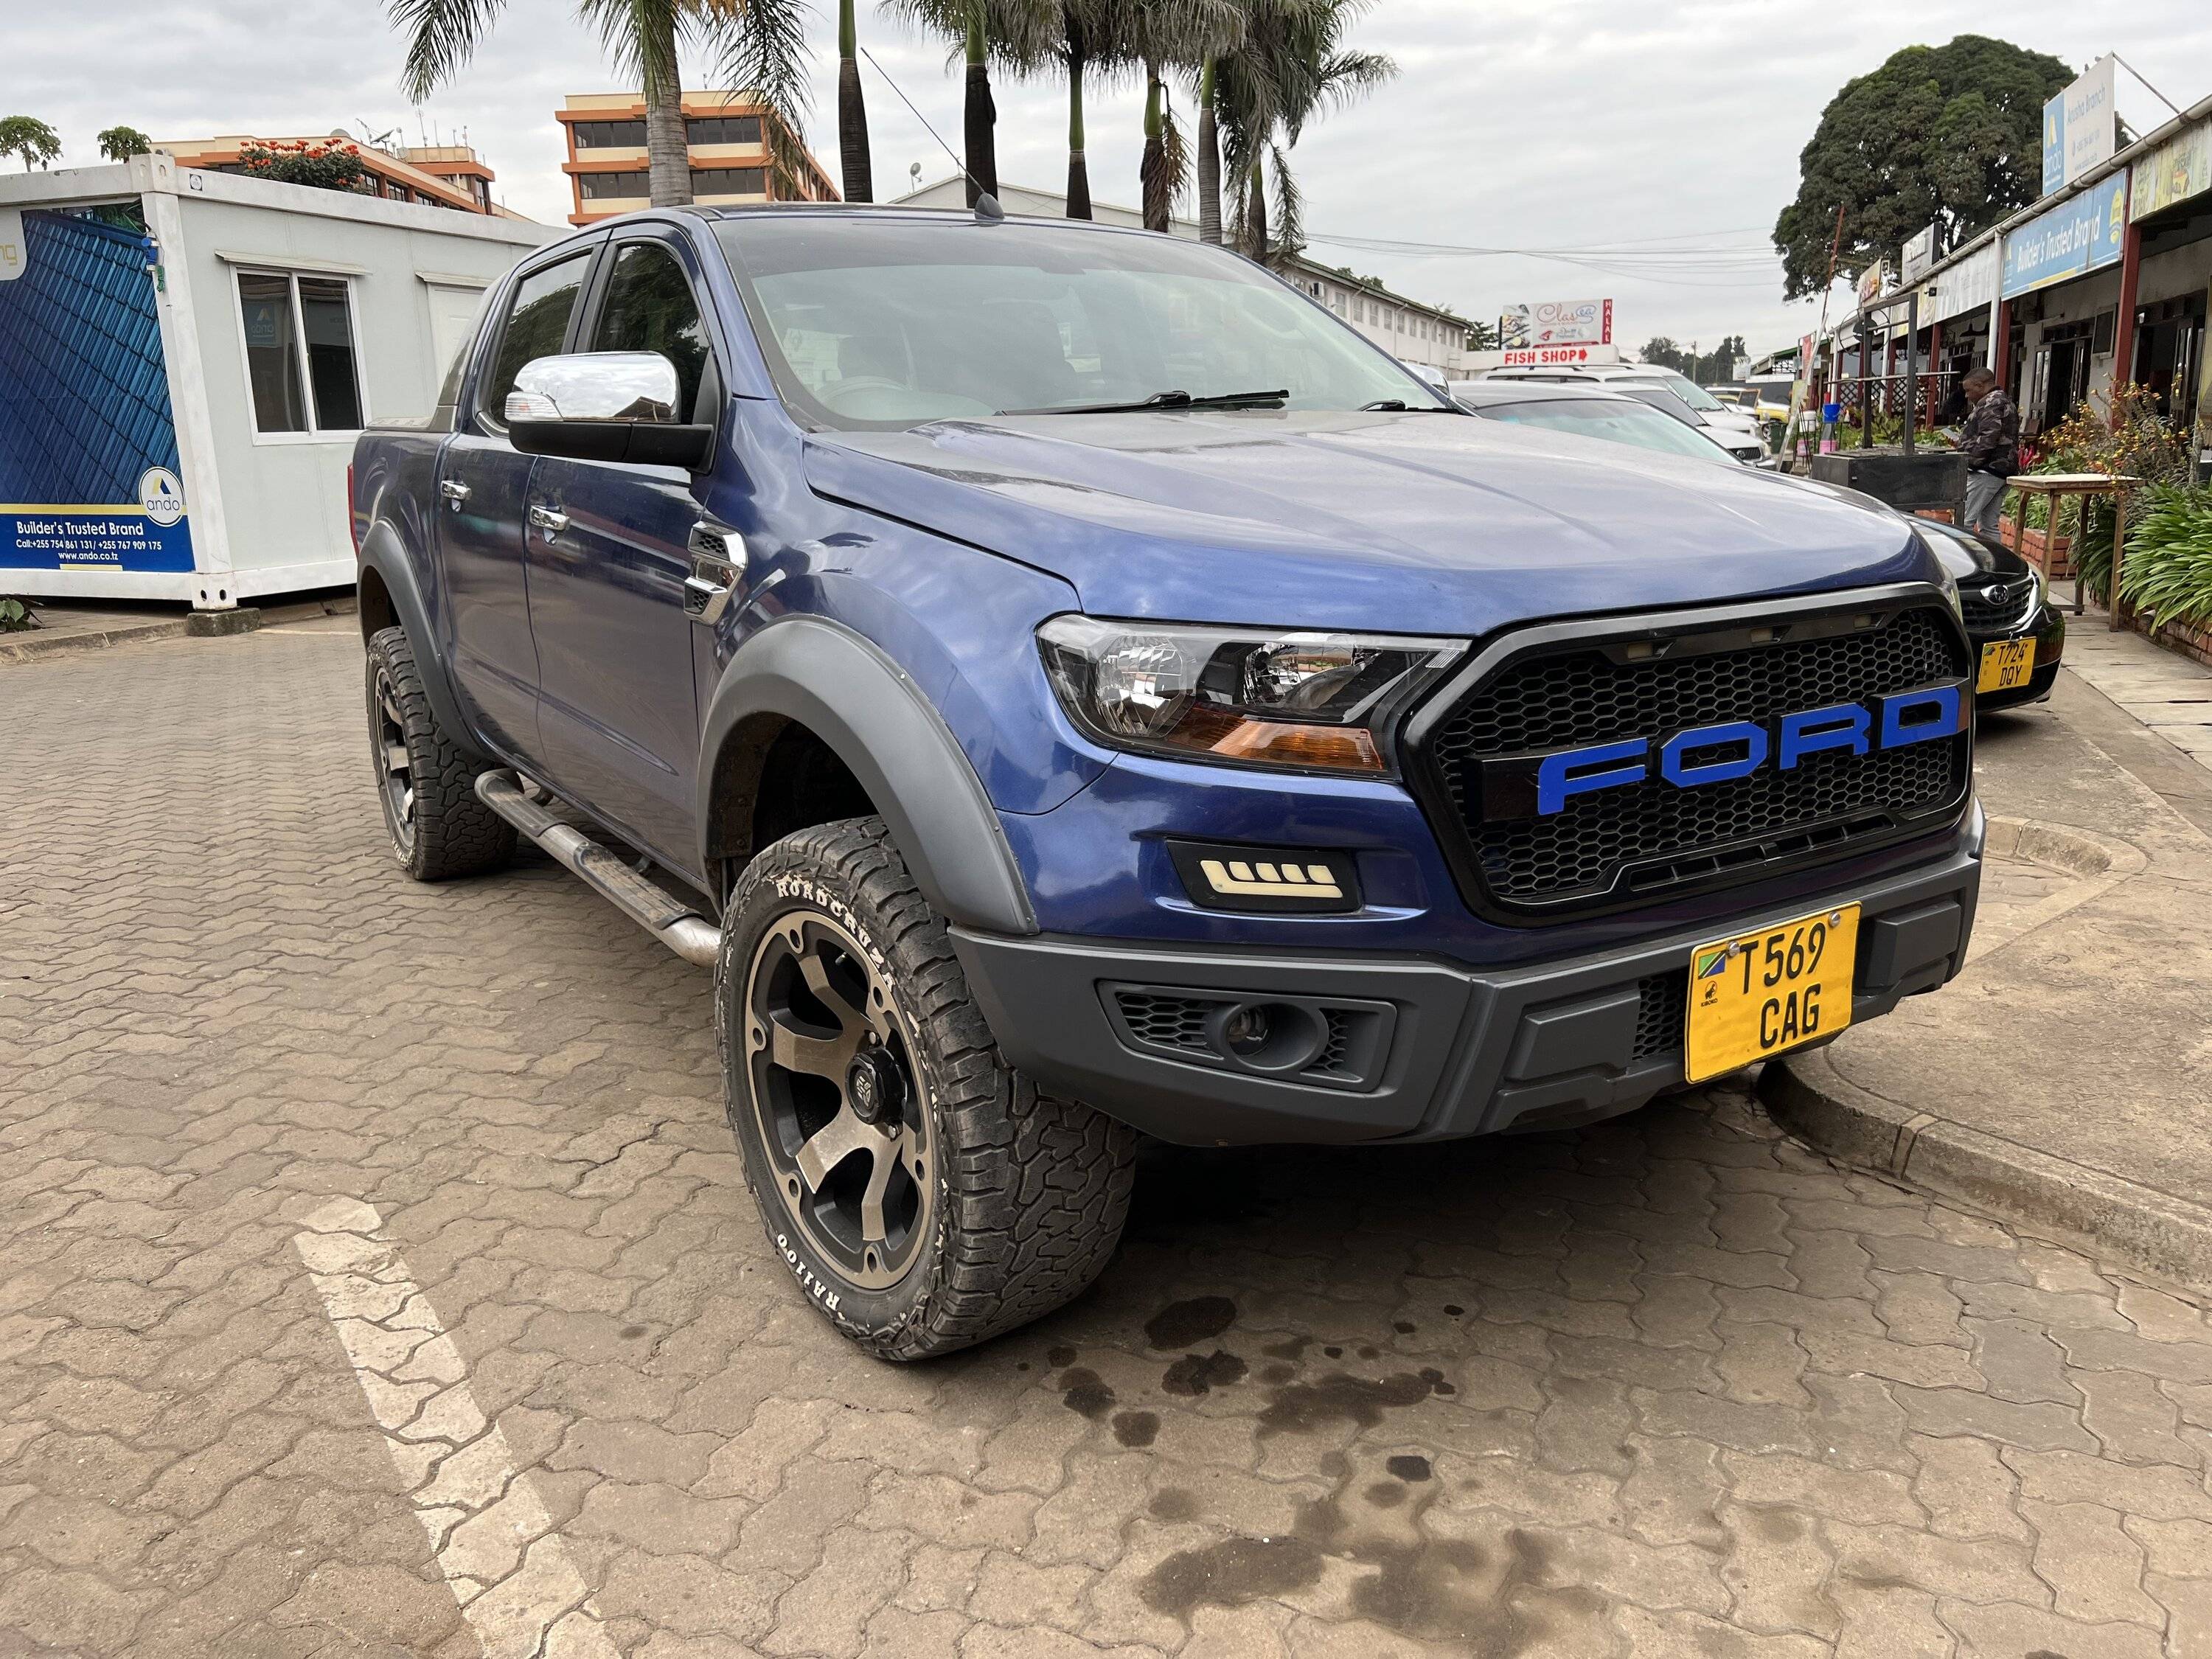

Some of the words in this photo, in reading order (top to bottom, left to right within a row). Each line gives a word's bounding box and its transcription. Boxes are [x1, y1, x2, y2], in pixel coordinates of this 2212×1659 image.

[2017, 234, 2045, 273] Builder's
[2045, 219, 2074, 261] Trusted
[2074, 205, 2101, 251] Brand
[1504, 352, 1536, 364] FISH
[1541, 349, 1576, 362] SHOP
[147, 497, 180, 511] ando
[16, 521, 63, 535] Builder's
[65, 522, 107, 535] Trusted
[110, 522, 144, 536] Brand
[50, 540, 63, 549] 754
[66, 540, 77, 549] 861
[98, 541, 116, 549] +255
[118, 541, 131, 550] 767
[133, 541, 146, 550] 909
[149, 541, 162, 551] 175
[58, 552, 119, 560] www.ando.co.tz
[1998, 643, 2025, 665] T724
[1999, 665, 2023, 686] DQY
[1537, 686, 1960, 815] FORD
[1700, 998, 1718, 1007] KIBOKO
[1760, 983, 1821, 1048] CAG
